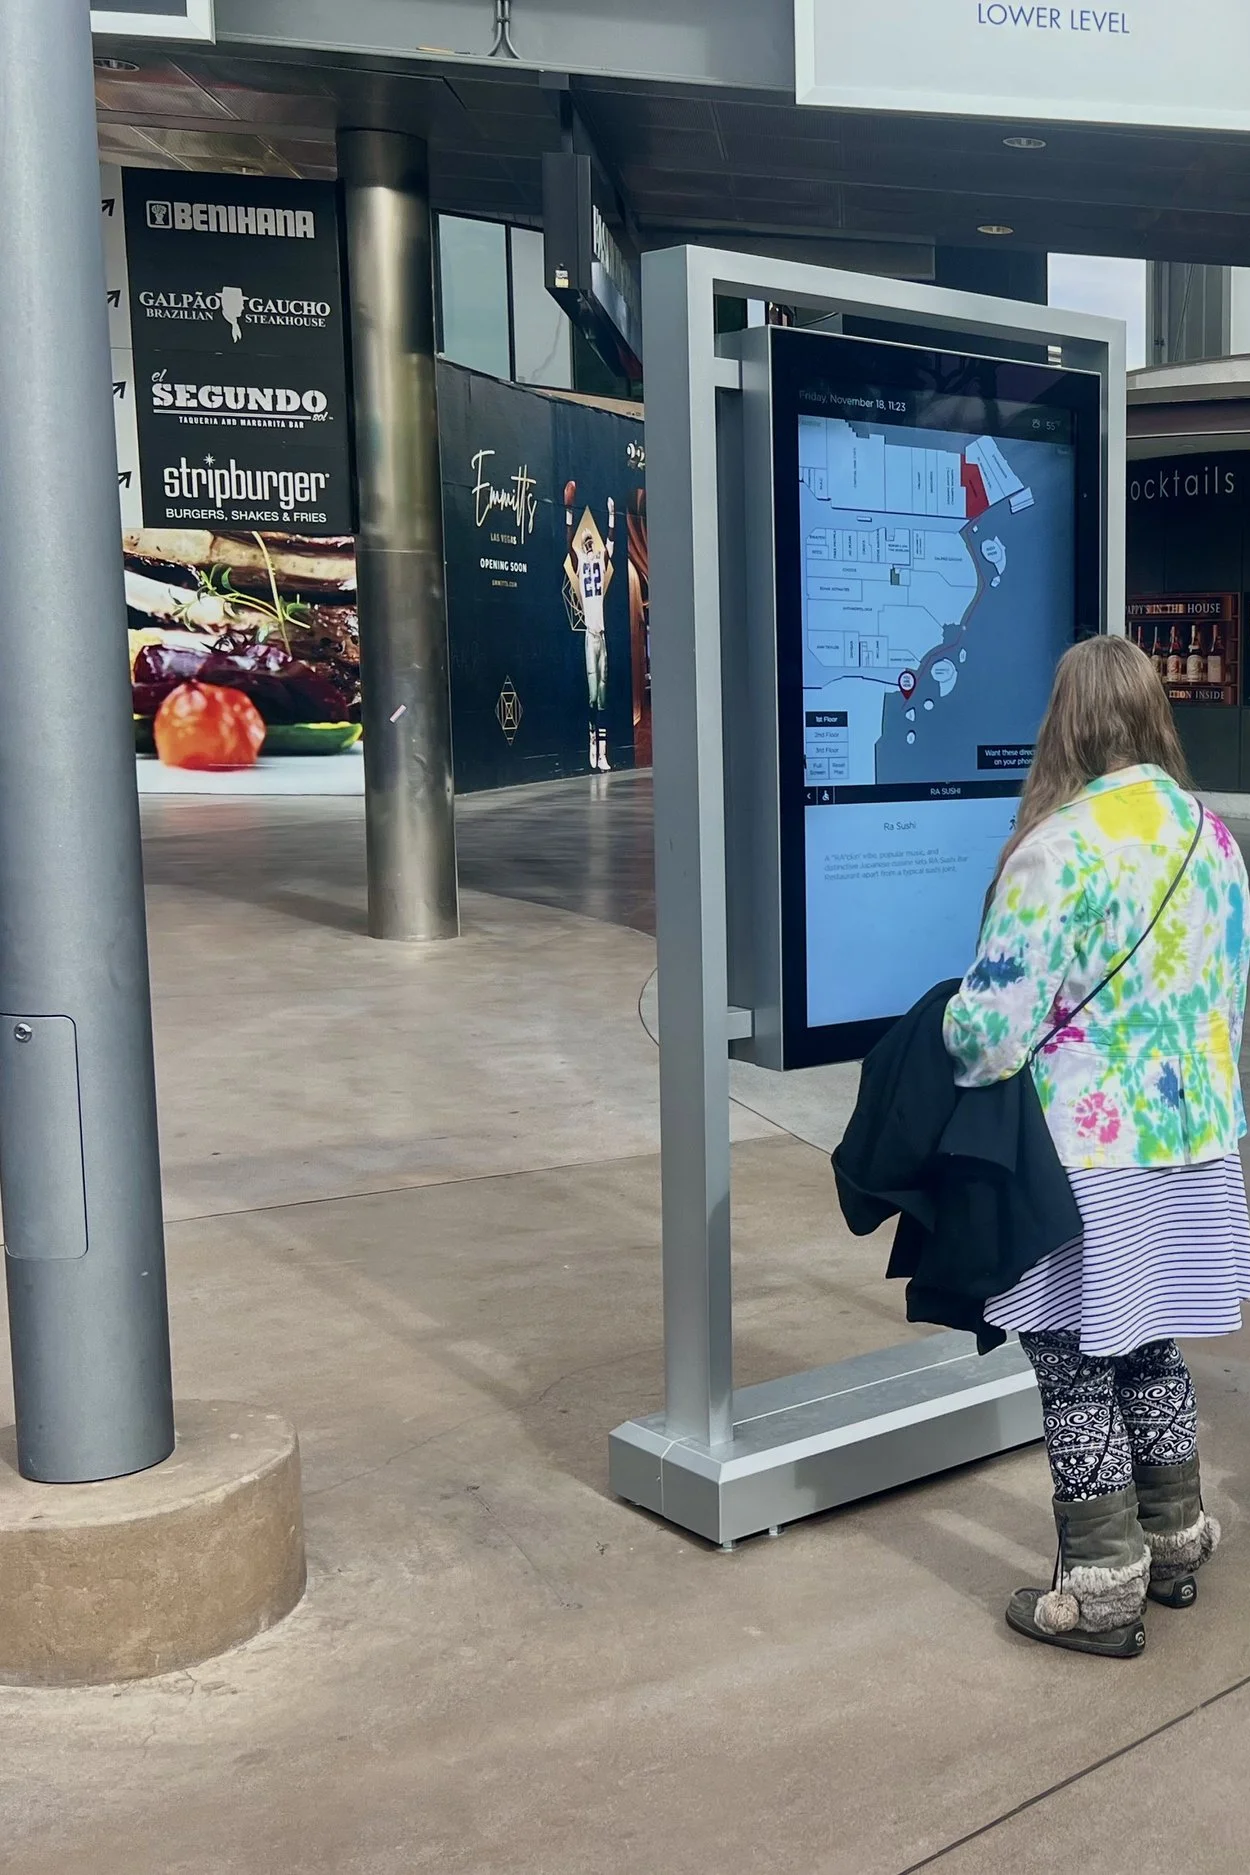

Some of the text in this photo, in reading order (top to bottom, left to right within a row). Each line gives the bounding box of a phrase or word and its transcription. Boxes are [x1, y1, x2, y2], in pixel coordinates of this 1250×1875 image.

[977, 3, 1130, 34] LOWER LEVEL
[174, 202, 315, 238] BENIHANA
[139, 291, 330, 317] GALPÃO GAUCHO
[146, 308, 326, 328] BRAZILIAN STEAKHOUSE
[151, 369, 167, 382] el
[151, 384, 327, 413] SEGUNDO
[830, 394, 874, 408] November
[179, 415, 304, 429] TAQUERIA AND MARGARITA BAR
[312, 412, 328, 421] sol
[163, 454, 326, 510] stripburger
[1130, 466, 1235, 501] ocktails
[166, 508, 327, 523] BURGERS, SHAKES & FRIES
[480, 558, 527, 573] OPENING SOON
[583, 562, 601, 597] 22
[1126, 604, 1150, 614] APPY'S
[1187, 603, 1221, 614] HOUSE
[1195, 690, 1225, 700] INSIDE
[942, 787, 961, 795] SUSHI
[884, 821, 916, 831] Ra Sushi
